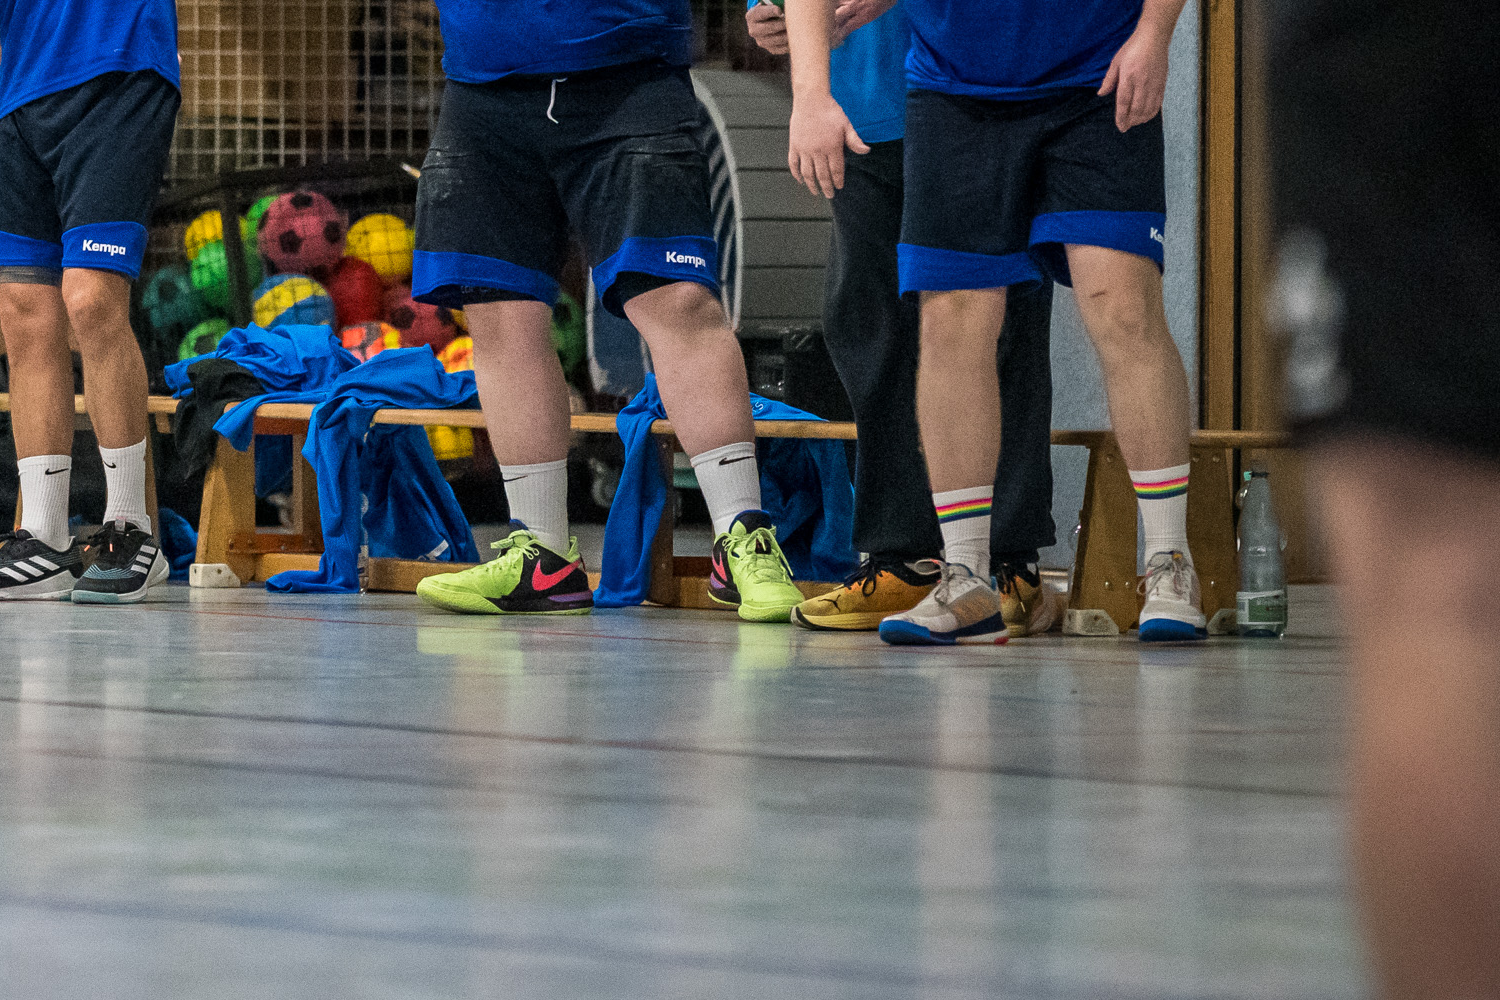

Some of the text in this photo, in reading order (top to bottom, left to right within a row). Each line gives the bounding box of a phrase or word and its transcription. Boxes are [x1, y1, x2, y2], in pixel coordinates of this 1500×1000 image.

[1150, 227, 1164, 242] Ke
[82, 239, 126, 256] Kempa
[666, 251, 706, 268] Kempa
